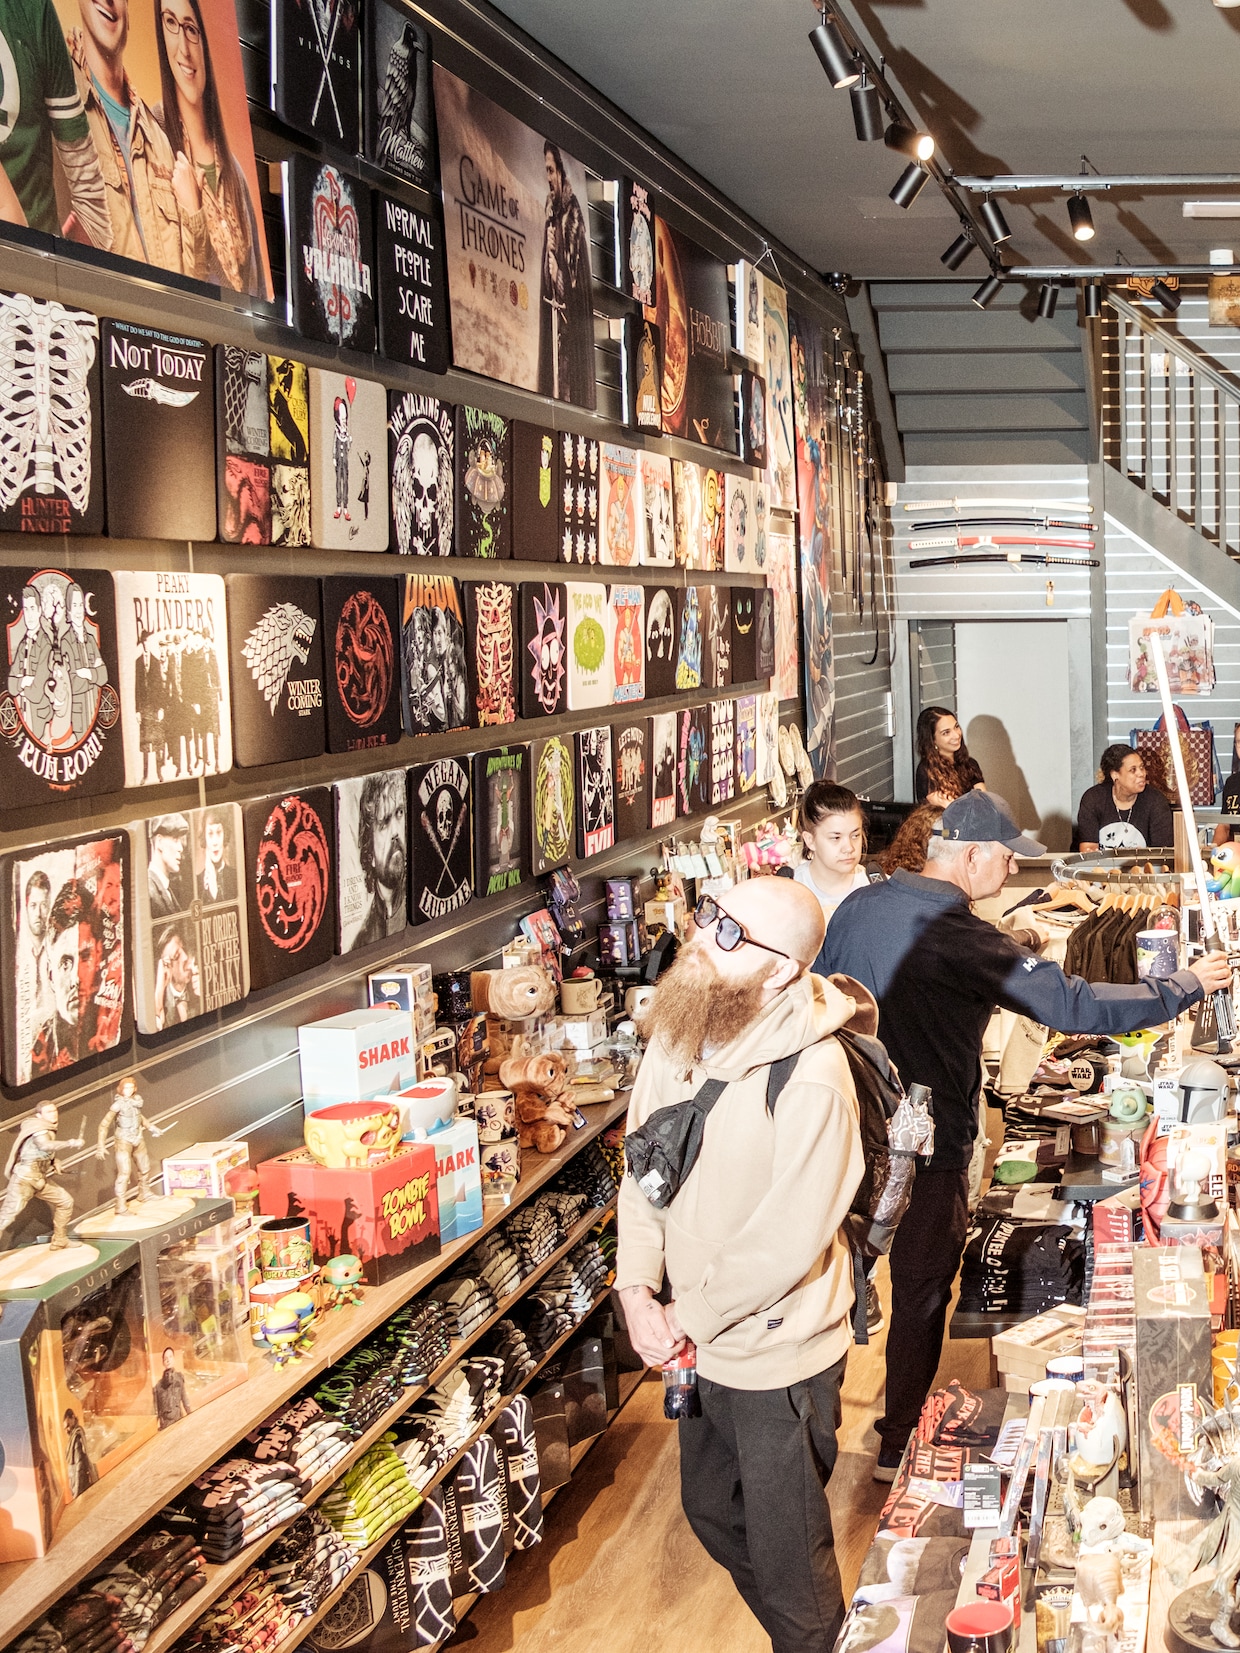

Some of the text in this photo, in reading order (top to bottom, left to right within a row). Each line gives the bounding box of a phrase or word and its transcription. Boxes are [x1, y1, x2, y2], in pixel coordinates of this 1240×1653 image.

[379, 126, 426, 170] Matthew
[459, 154, 509, 218] GAME
[385, 200, 435, 250] NORMAL
[454, 198, 526, 274] THRONES
[302, 244, 373, 300] VALHALLA
[394, 243, 433, 288] PEOPLE
[398, 286, 434, 327] SCARE
[130, 325, 138, 335] DO
[410, 331, 427, 363] ME
[110, 334, 207, 382] NOT TODAY
[402, 391, 441, 423] WALKING
[20, 496, 71, 518] HUNTER
[156, 572, 191, 595] PEAKY
[403, 573, 464, 626] DIXON
[133, 596, 216, 646] BLINDERS
[287, 678, 322, 695] WINTER
[287, 692, 323, 711] COMING
[16, 736, 104, 782] RUH-ROH!
[423, 759, 466, 794] NEGAN
[653, 795, 677, 828] GANG
[201, 911, 239, 947] BY ORDER
[202, 936, 240, 966] OF THE
[203, 956, 241, 998] PEAKY
[358, 1035, 411, 1071] SHARK
[1071, 1066, 1092, 1074] STAR
[1071, 1072, 1092, 1080] WARS
[435, 1146, 476, 1180] HARK
[382, 1169, 431, 1217] ZOMBIE
[389, 1200, 428, 1240] BOWL
[445, 1485, 464, 1575] SUPERNATURAL
[385, 1554, 401, 1625] JOIN THE HUNT
[391, 1538, 411, 1634] SUPERNATURAL
